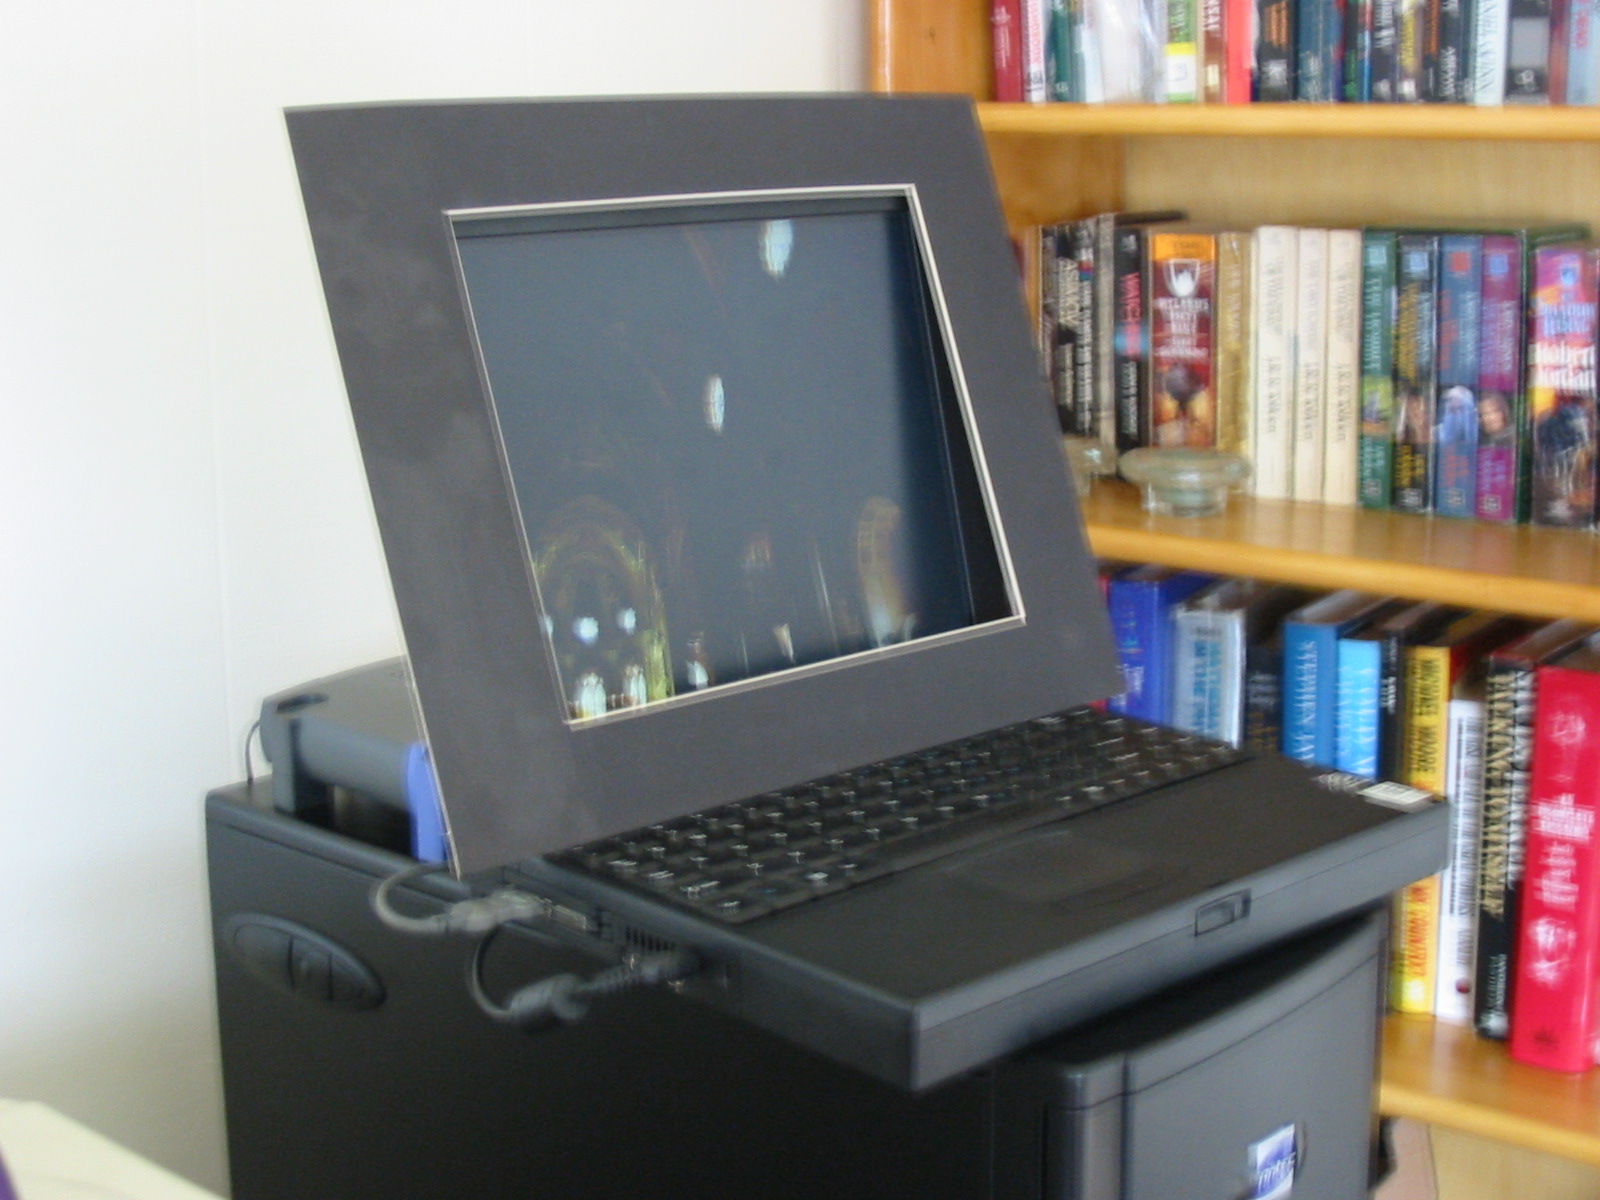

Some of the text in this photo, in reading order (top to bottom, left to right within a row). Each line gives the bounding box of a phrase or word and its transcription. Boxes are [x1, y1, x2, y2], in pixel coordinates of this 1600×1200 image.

[1060, 258, 1080, 327] ASIMOV
[1122, 272, 1140, 357] WATCHERS
[1367, 312, 1382, 374] HOBBIT
[1298, 640, 1317, 727] STEPHEN
[1413, 656, 1440, 777] MICHAEL MOORE
